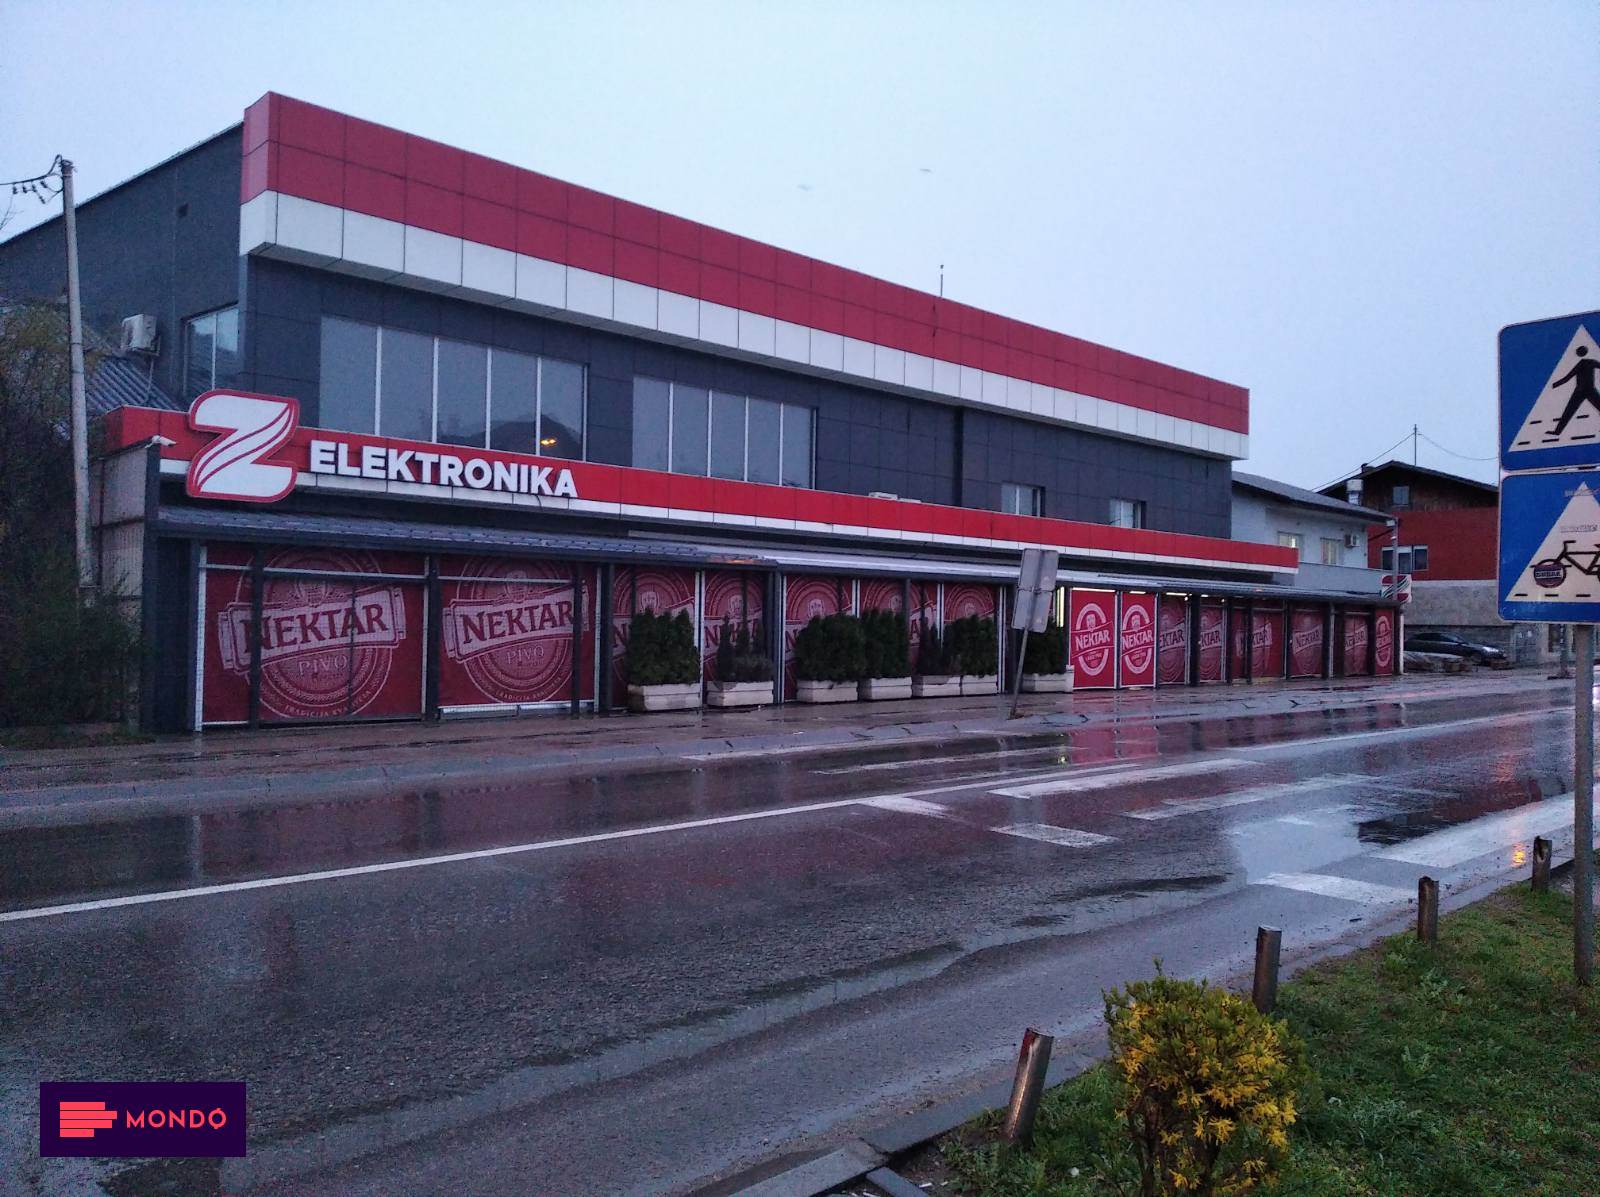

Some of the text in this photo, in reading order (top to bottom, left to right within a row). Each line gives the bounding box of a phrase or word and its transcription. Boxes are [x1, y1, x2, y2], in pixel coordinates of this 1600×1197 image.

[310, 439, 578, 498] ELEKTRONIKA
[459, 601, 574, 645] NEKTAR
[1075, 629, 1110, 652] NEKTAR
[1122, 629, 1154, 650] NEKTAR
[507, 645, 545, 665] PIVO
